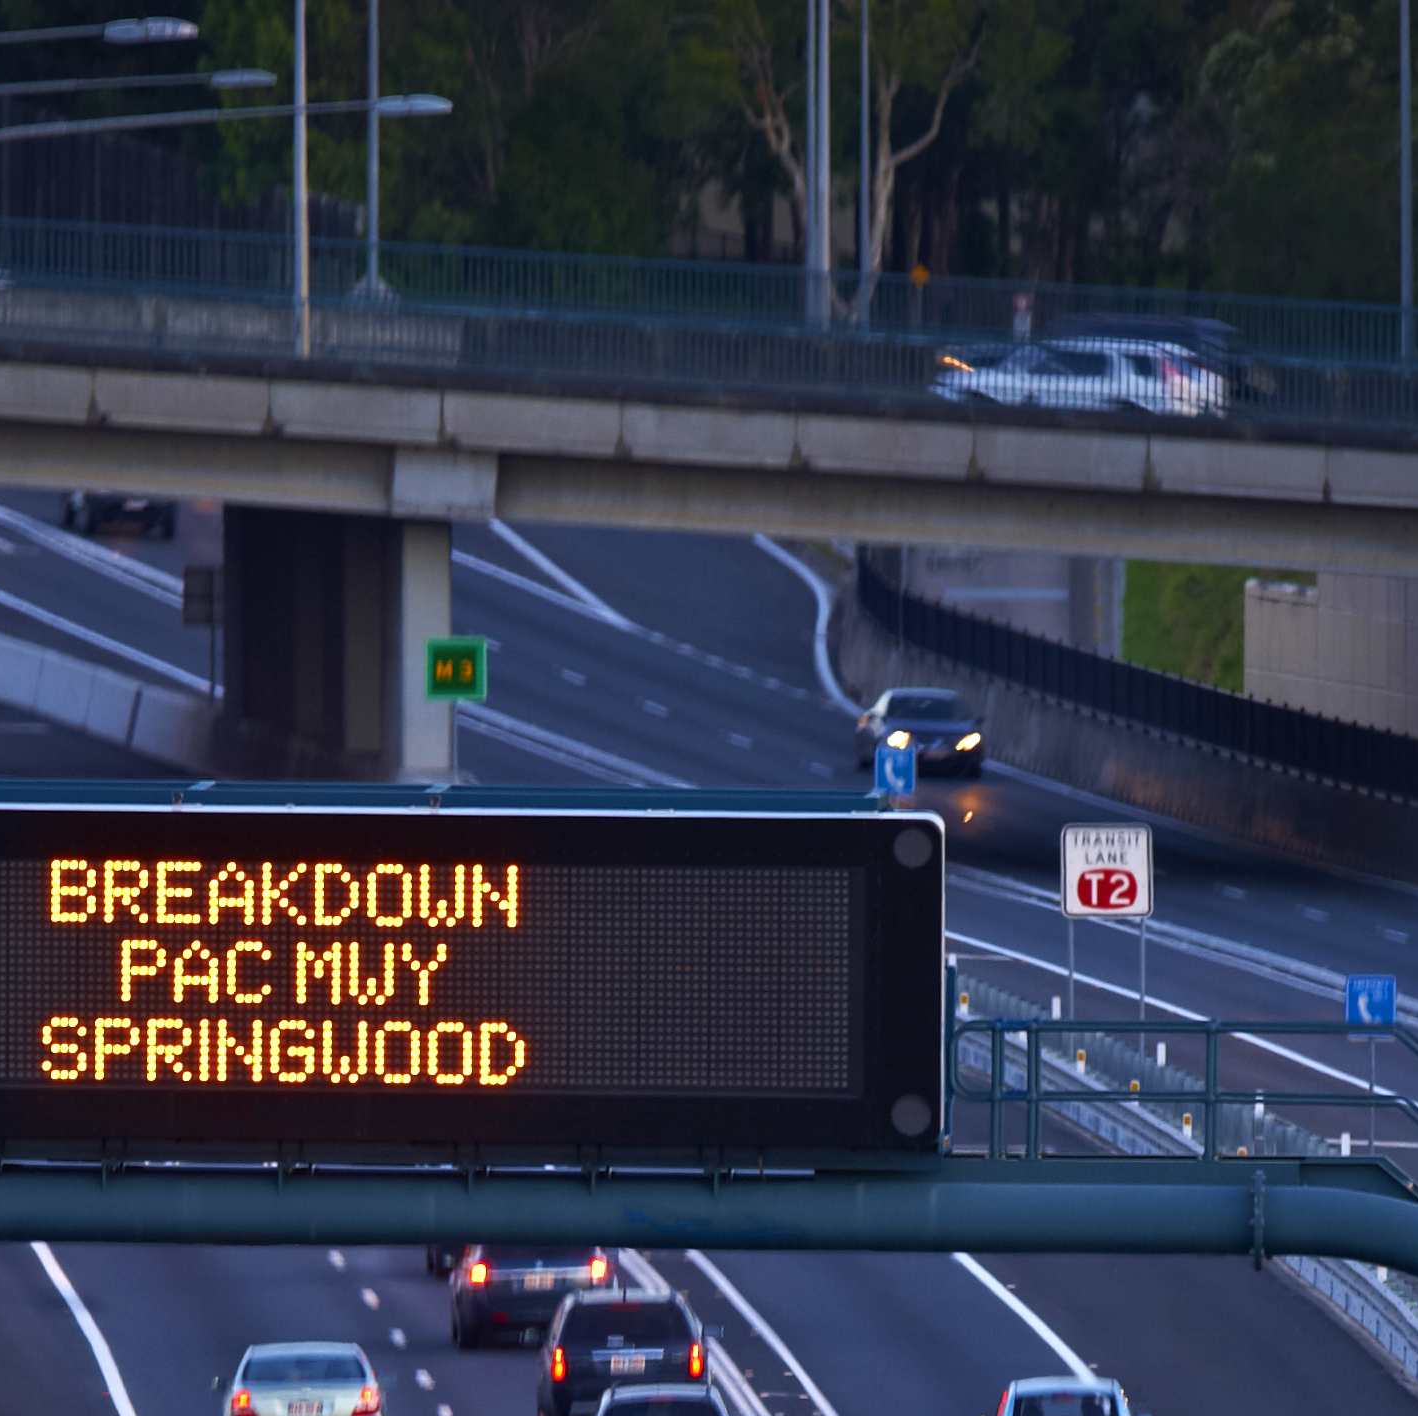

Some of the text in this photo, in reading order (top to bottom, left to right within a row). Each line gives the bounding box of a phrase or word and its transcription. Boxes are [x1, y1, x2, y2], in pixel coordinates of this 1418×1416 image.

[1074, 829, 1141, 848] TRANSIT
[1085, 849, 1130, 866] LANE
[49, 857, 521, 929] BREAKDOWN
[1084, 873, 1131, 907] T2
[119, 937, 448, 1007] PAC MWY
[38, 1014, 529, 1086] SPRINGWOOD
